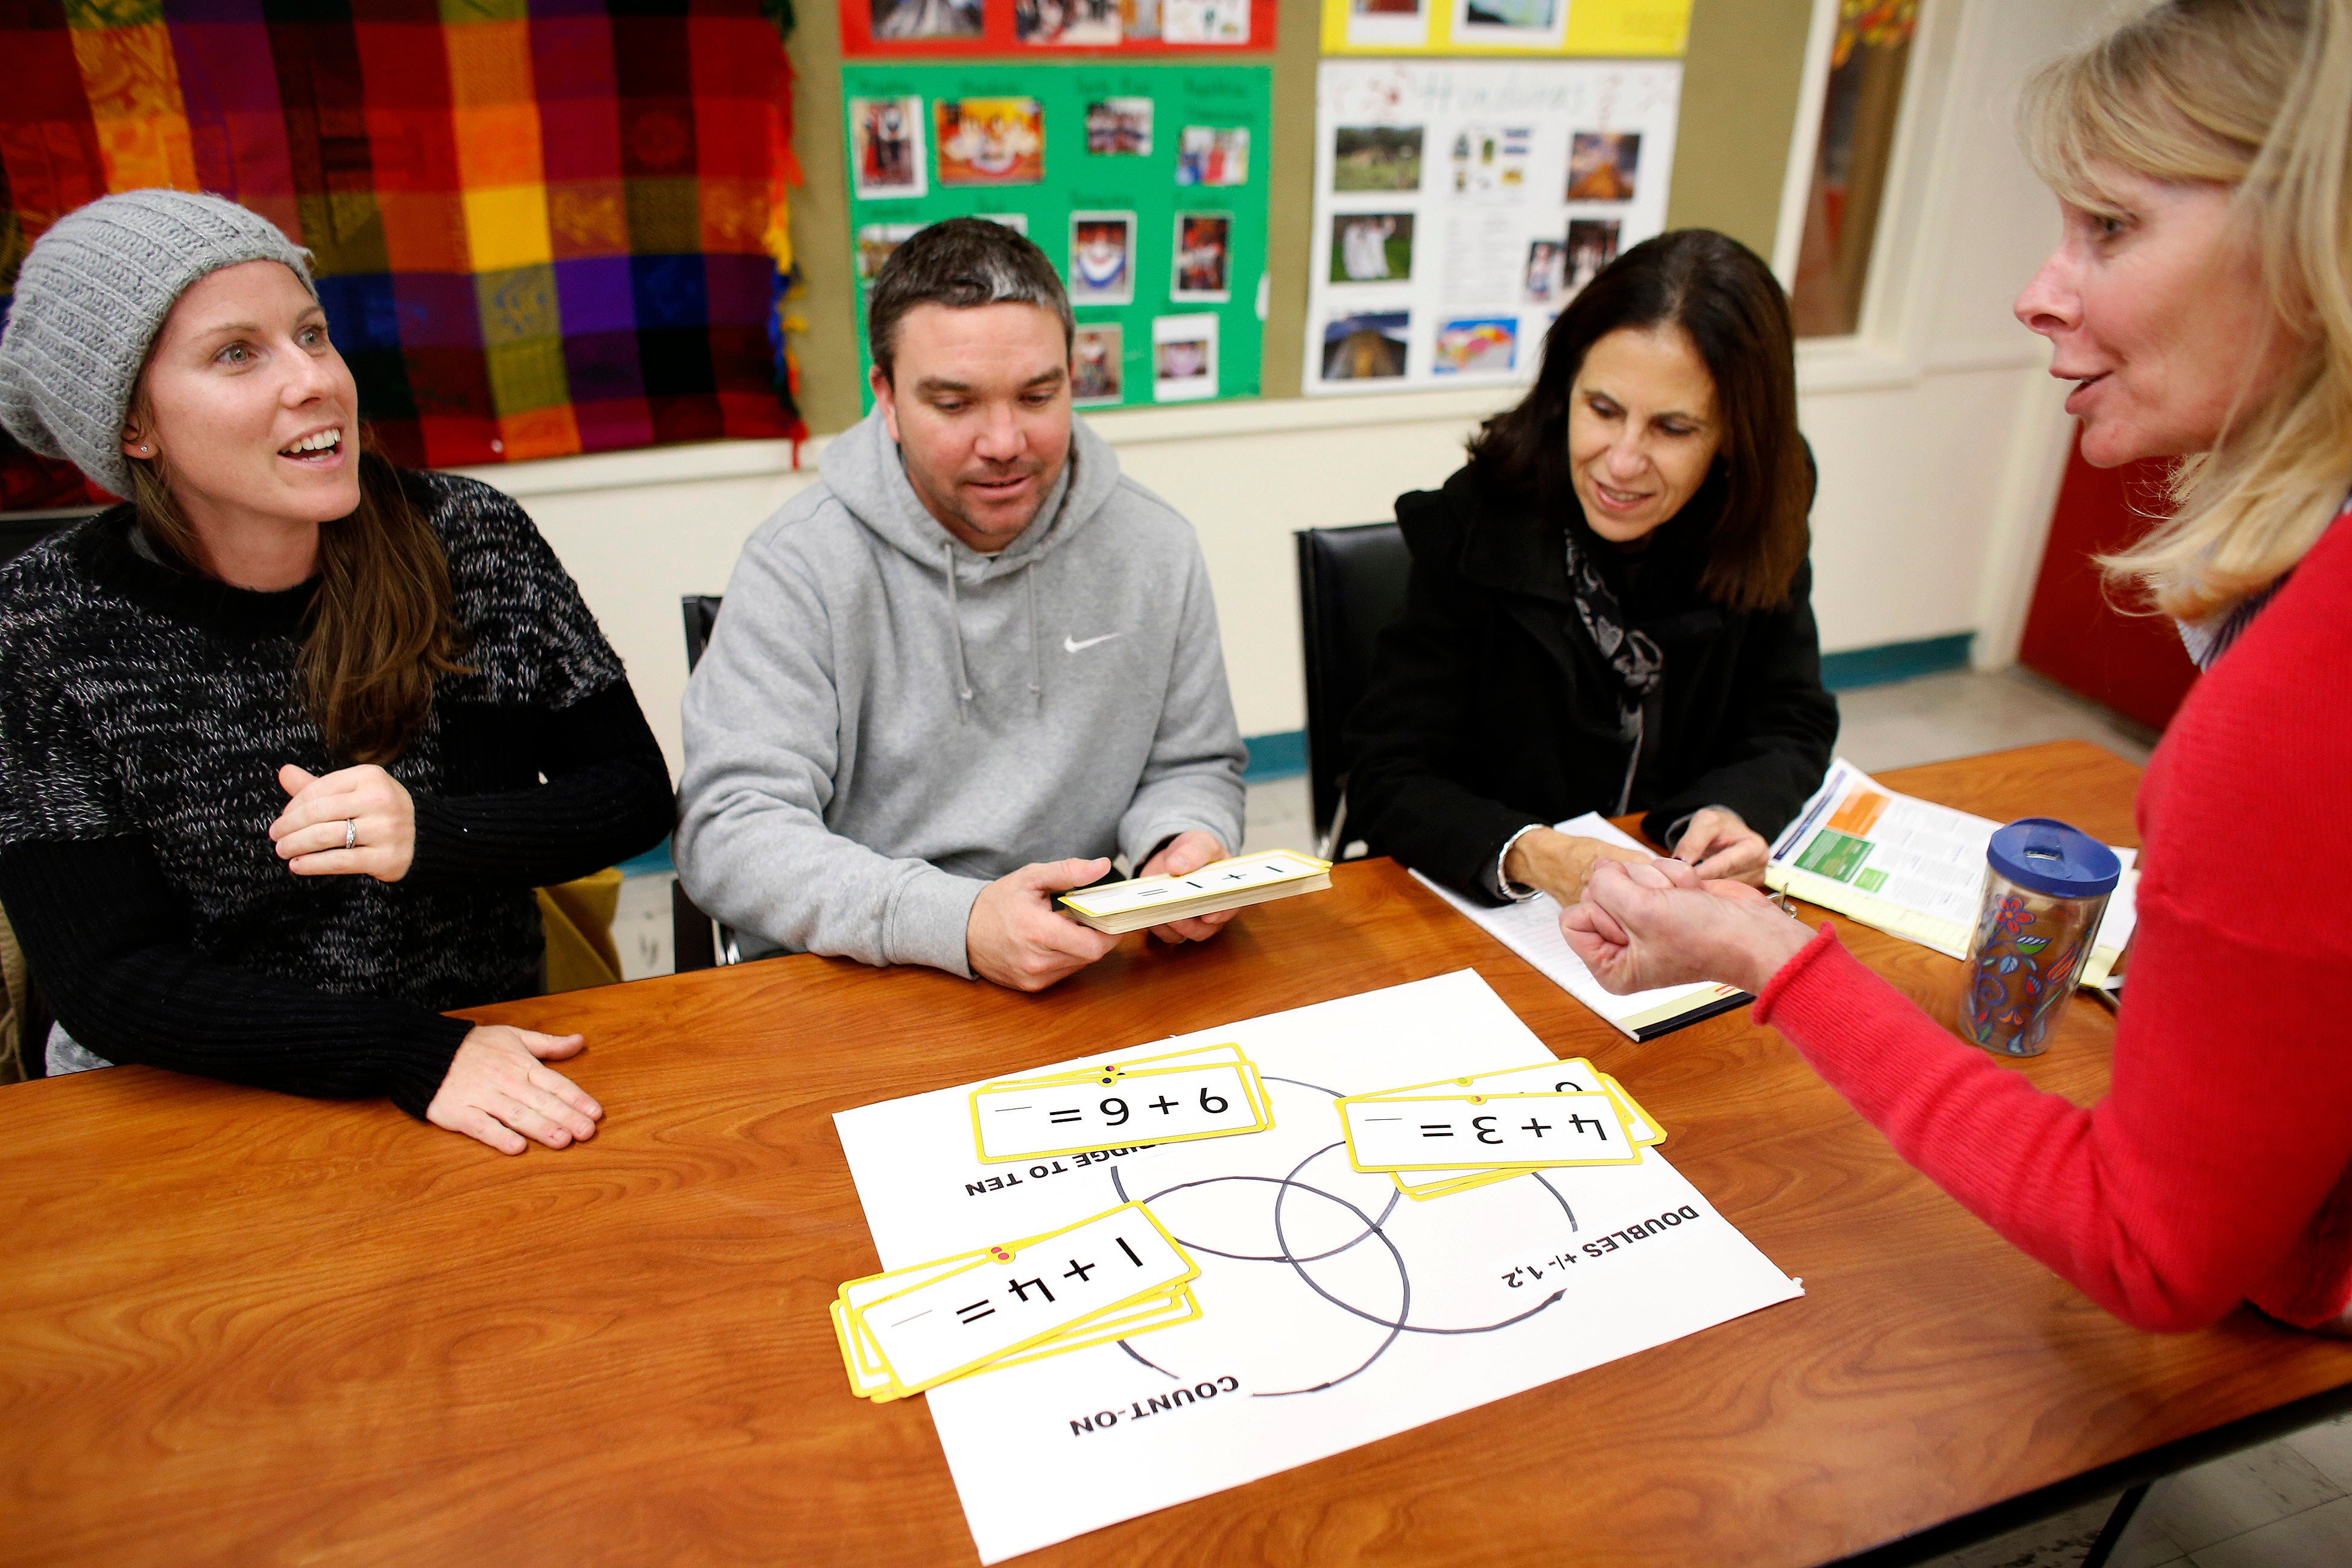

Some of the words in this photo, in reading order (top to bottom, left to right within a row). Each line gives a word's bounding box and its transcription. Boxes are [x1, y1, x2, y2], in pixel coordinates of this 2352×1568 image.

[1099, 1097, 1130, 1127] 6
[1148, 1095, 1180, 1116] +
[1199, 1087, 1229, 1114] 9
[1049, 1108, 1083, 1124] =
[1520, 1117, 1553, 1139] +
[1568, 1113, 1608, 1142] 4
[1420, 1124, 1454, 1138] =
[1472, 1116, 1504, 1145] 3
[1029, 1160, 1069, 1178] TO
[964, 1170, 1023, 1197] TEN
[1581, 1204, 1701, 1258] DOUBLES
[1114, 1236, 1144, 1268] 1
[1063, 1259, 1096, 1283] +
[1007, 1277, 1056, 1303] 4
[955, 1298, 996, 1325] =
[1069, 1375, 1240, 1437] COUNT-ON
